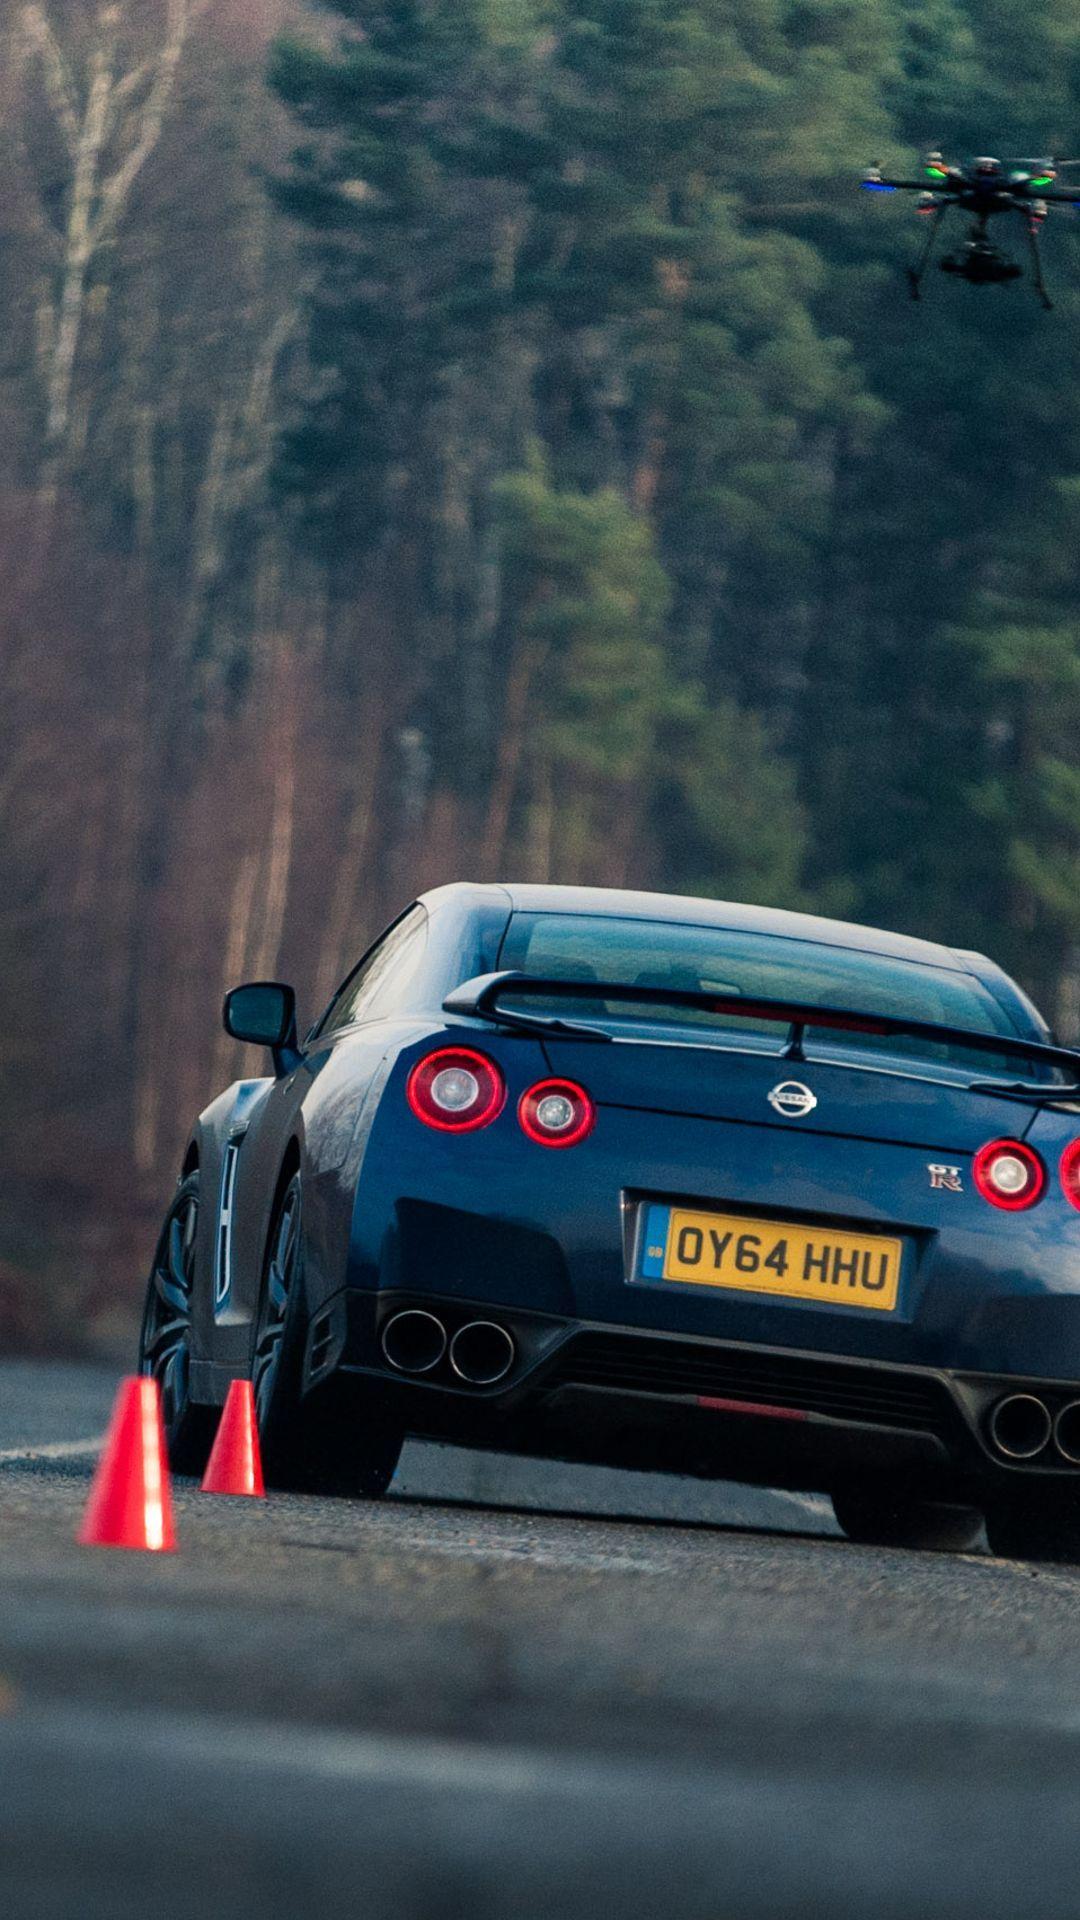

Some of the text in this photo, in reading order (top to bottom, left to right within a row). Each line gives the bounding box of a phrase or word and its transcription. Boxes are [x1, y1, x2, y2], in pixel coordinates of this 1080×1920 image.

[772, 1092, 812, 1105] NISSAN
[677, 1226, 888, 1291] OY64 HHU
